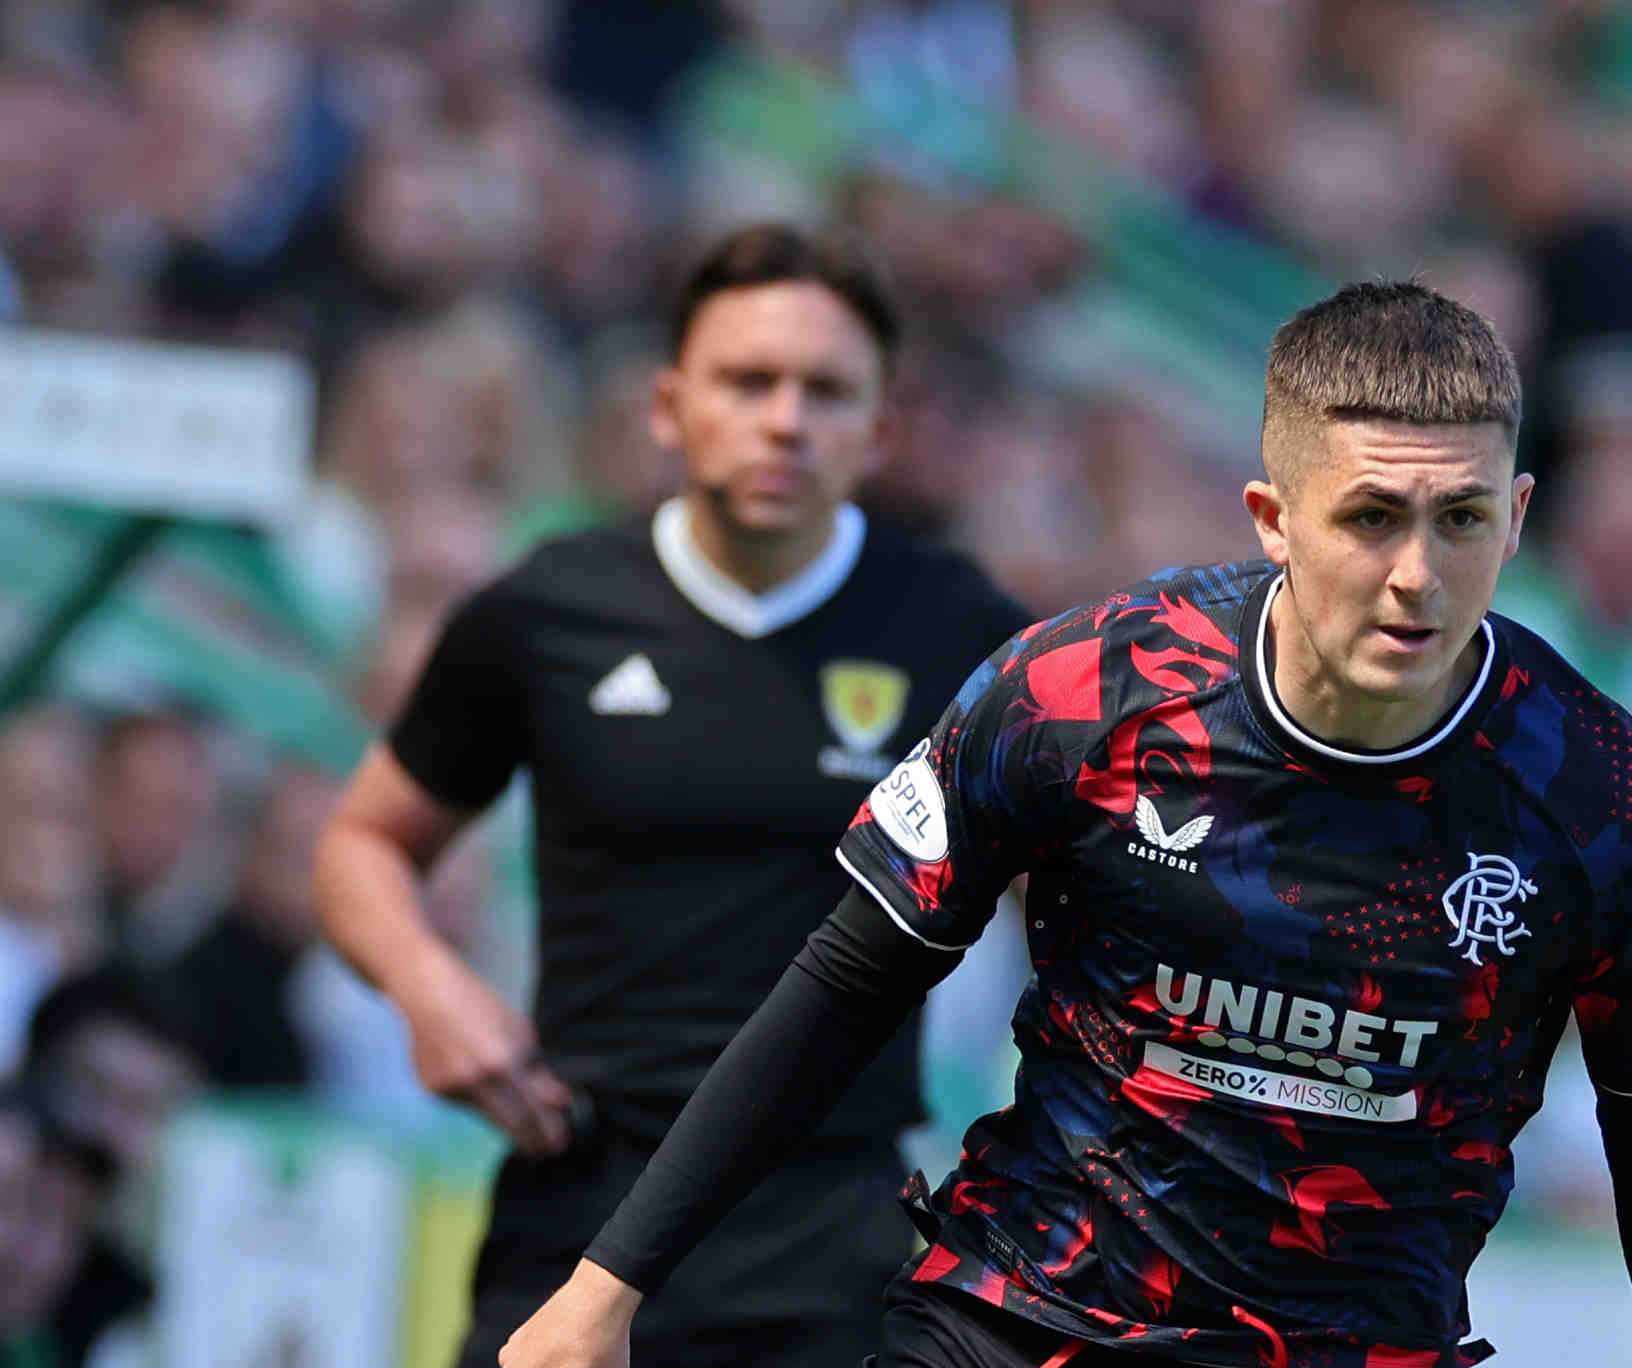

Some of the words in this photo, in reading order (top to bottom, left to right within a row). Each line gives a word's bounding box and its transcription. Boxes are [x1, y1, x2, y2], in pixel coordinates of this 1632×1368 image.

[890, 769, 931, 839] SPFL
[1127, 842, 1198, 873] CASTORE
[1155, 962, 1438, 1069] UNIBET
[1179, 1057, 1267, 1097] ZERO%
[1277, 1080, 1384, 1118] MISSION
